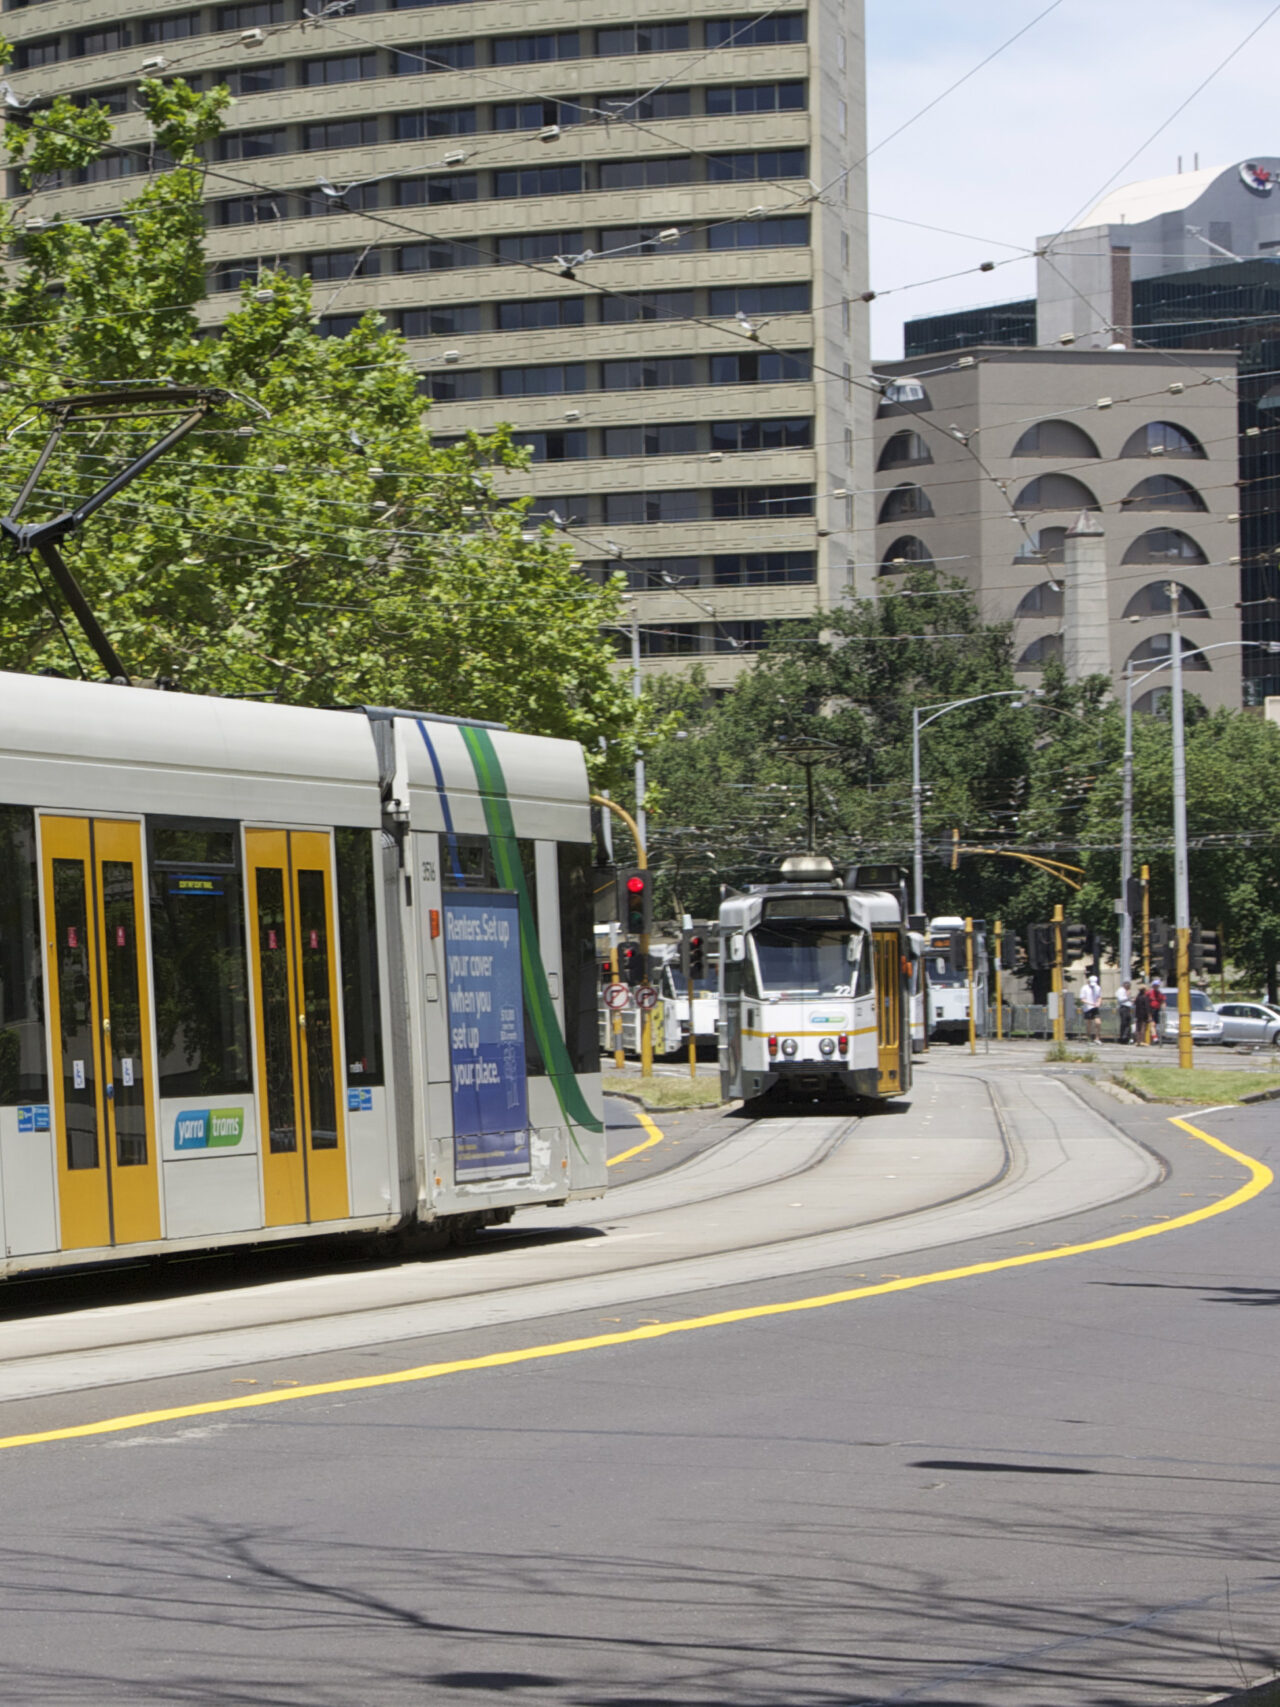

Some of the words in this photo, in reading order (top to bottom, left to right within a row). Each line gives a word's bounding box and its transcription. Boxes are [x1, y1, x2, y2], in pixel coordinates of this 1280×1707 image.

[498, 922, 510, 948] up
[448, 955, 469, 984] your
[470, 955, 494, 976] cover
[450, 984, 475, 1013] when
[476, 991, 491, 1019] you
[452, 1022, 467, 1049] set
[468, 1028, 480, 1056] up
[453, 1062, 474, 1092] your
[475, 1056, 500, 1092] place.
[178, 1119, 204, 1145] yarra
[212, 1116, 239, 1136] trams
